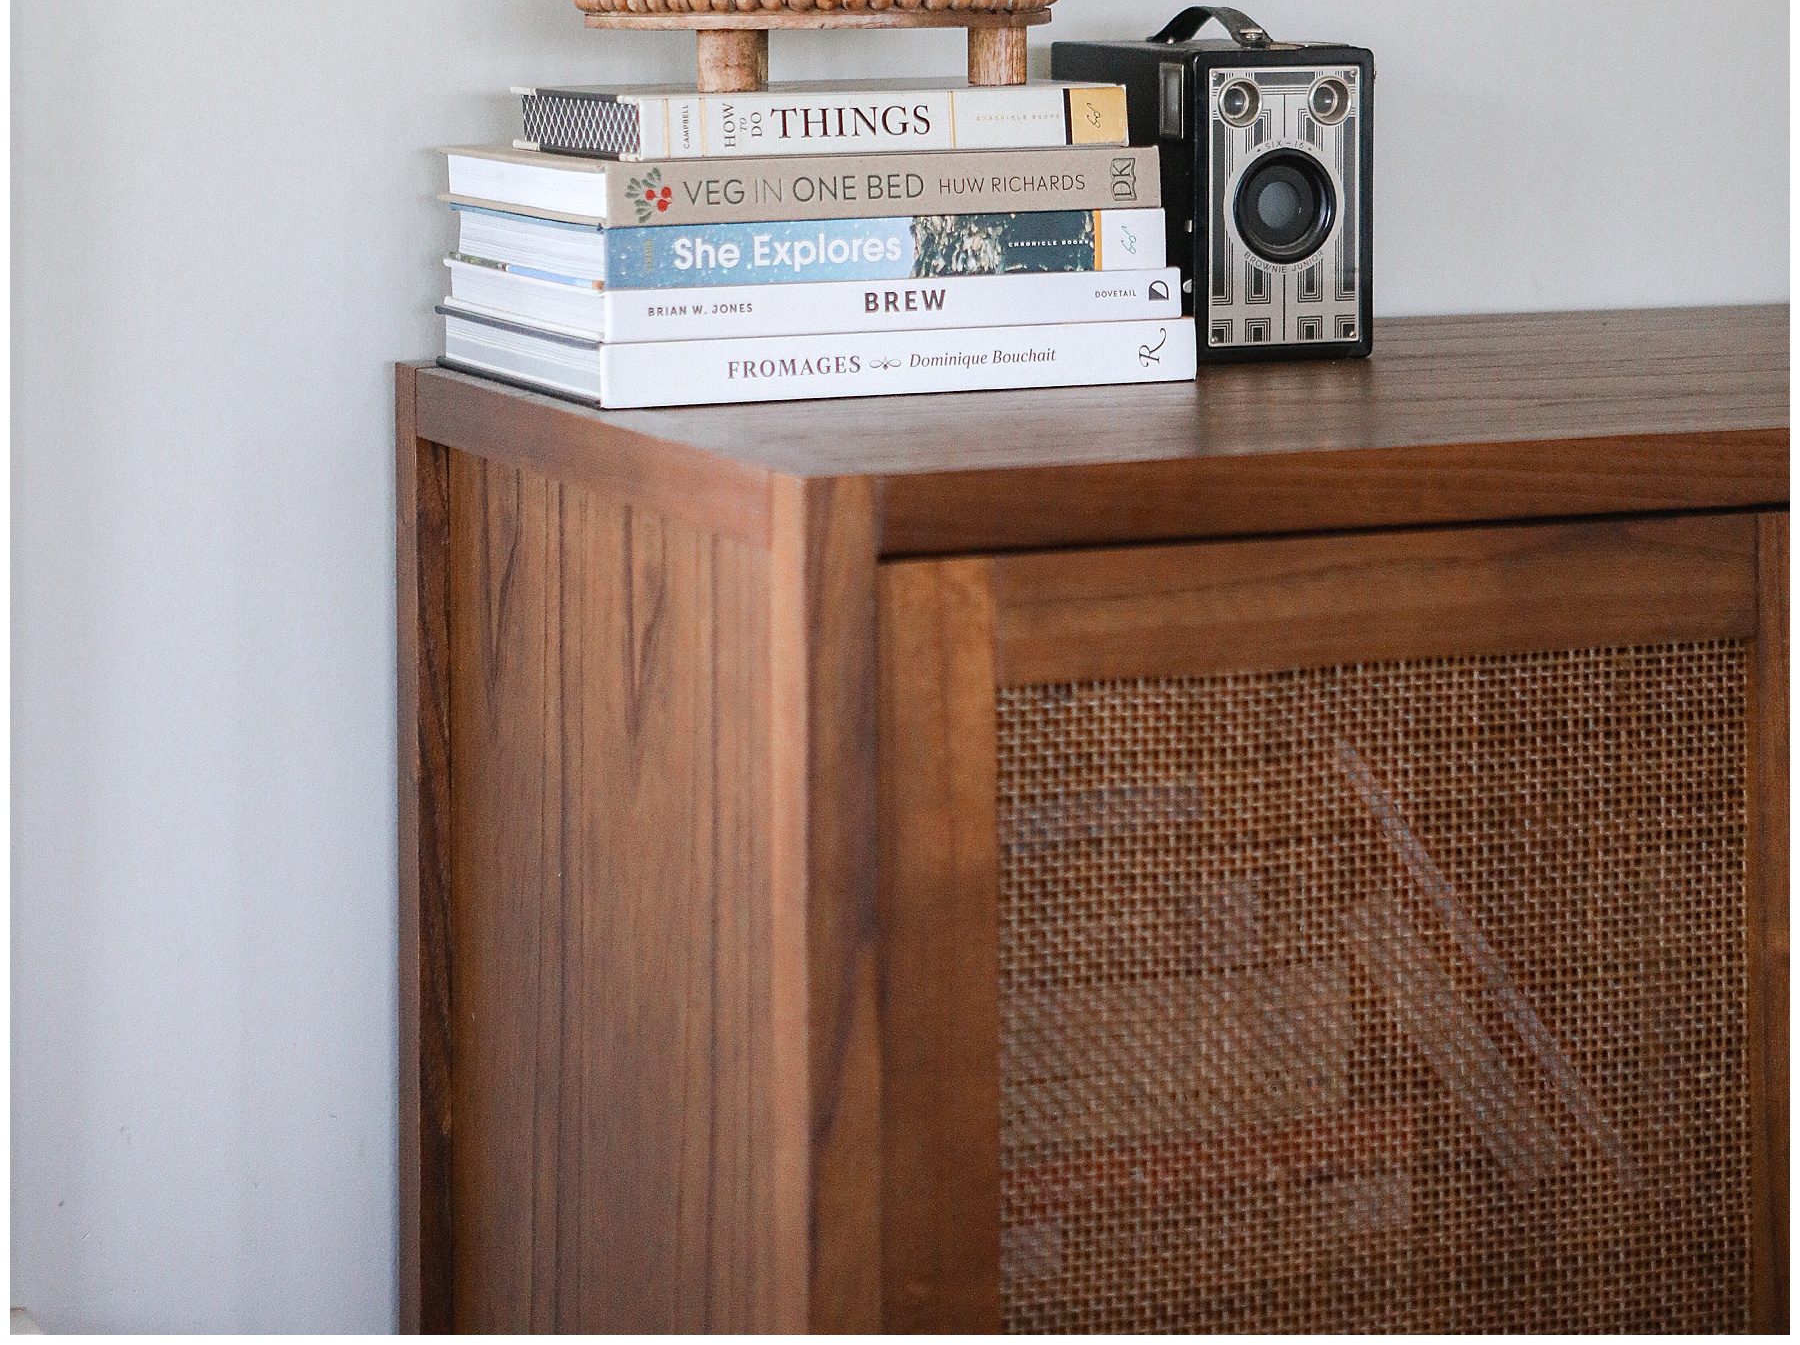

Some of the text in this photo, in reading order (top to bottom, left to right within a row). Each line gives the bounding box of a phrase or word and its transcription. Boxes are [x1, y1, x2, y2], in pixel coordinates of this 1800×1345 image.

[722, 102, 737, 149] HOW
[739, 116, 748, 132] TO
[750, 111, 763, 138] DO
[769, 104, 932, 139] THINGS
[683, 173, 924, 205] VEG IN ONE BED
[939, 174, 1086, 195] HUW RICHARDS
[1111, 160, 1134, 198] DK
[673, 236, 740, 271] She
[752, 231, 901, 273] Explores
[1008, 240, 1058, 248] CHRONICLE
[1244, 251, 1324, 273] BROWNIE JUNIOR
[864, 289, 946, 314] BREW
[1094, 289, 1137, 299] DOVETAIL
[647, 303, 754, 317] BRIAN W. JONES
[727, 347, 1058, 380] FROMAGES Dominique Bouchait
